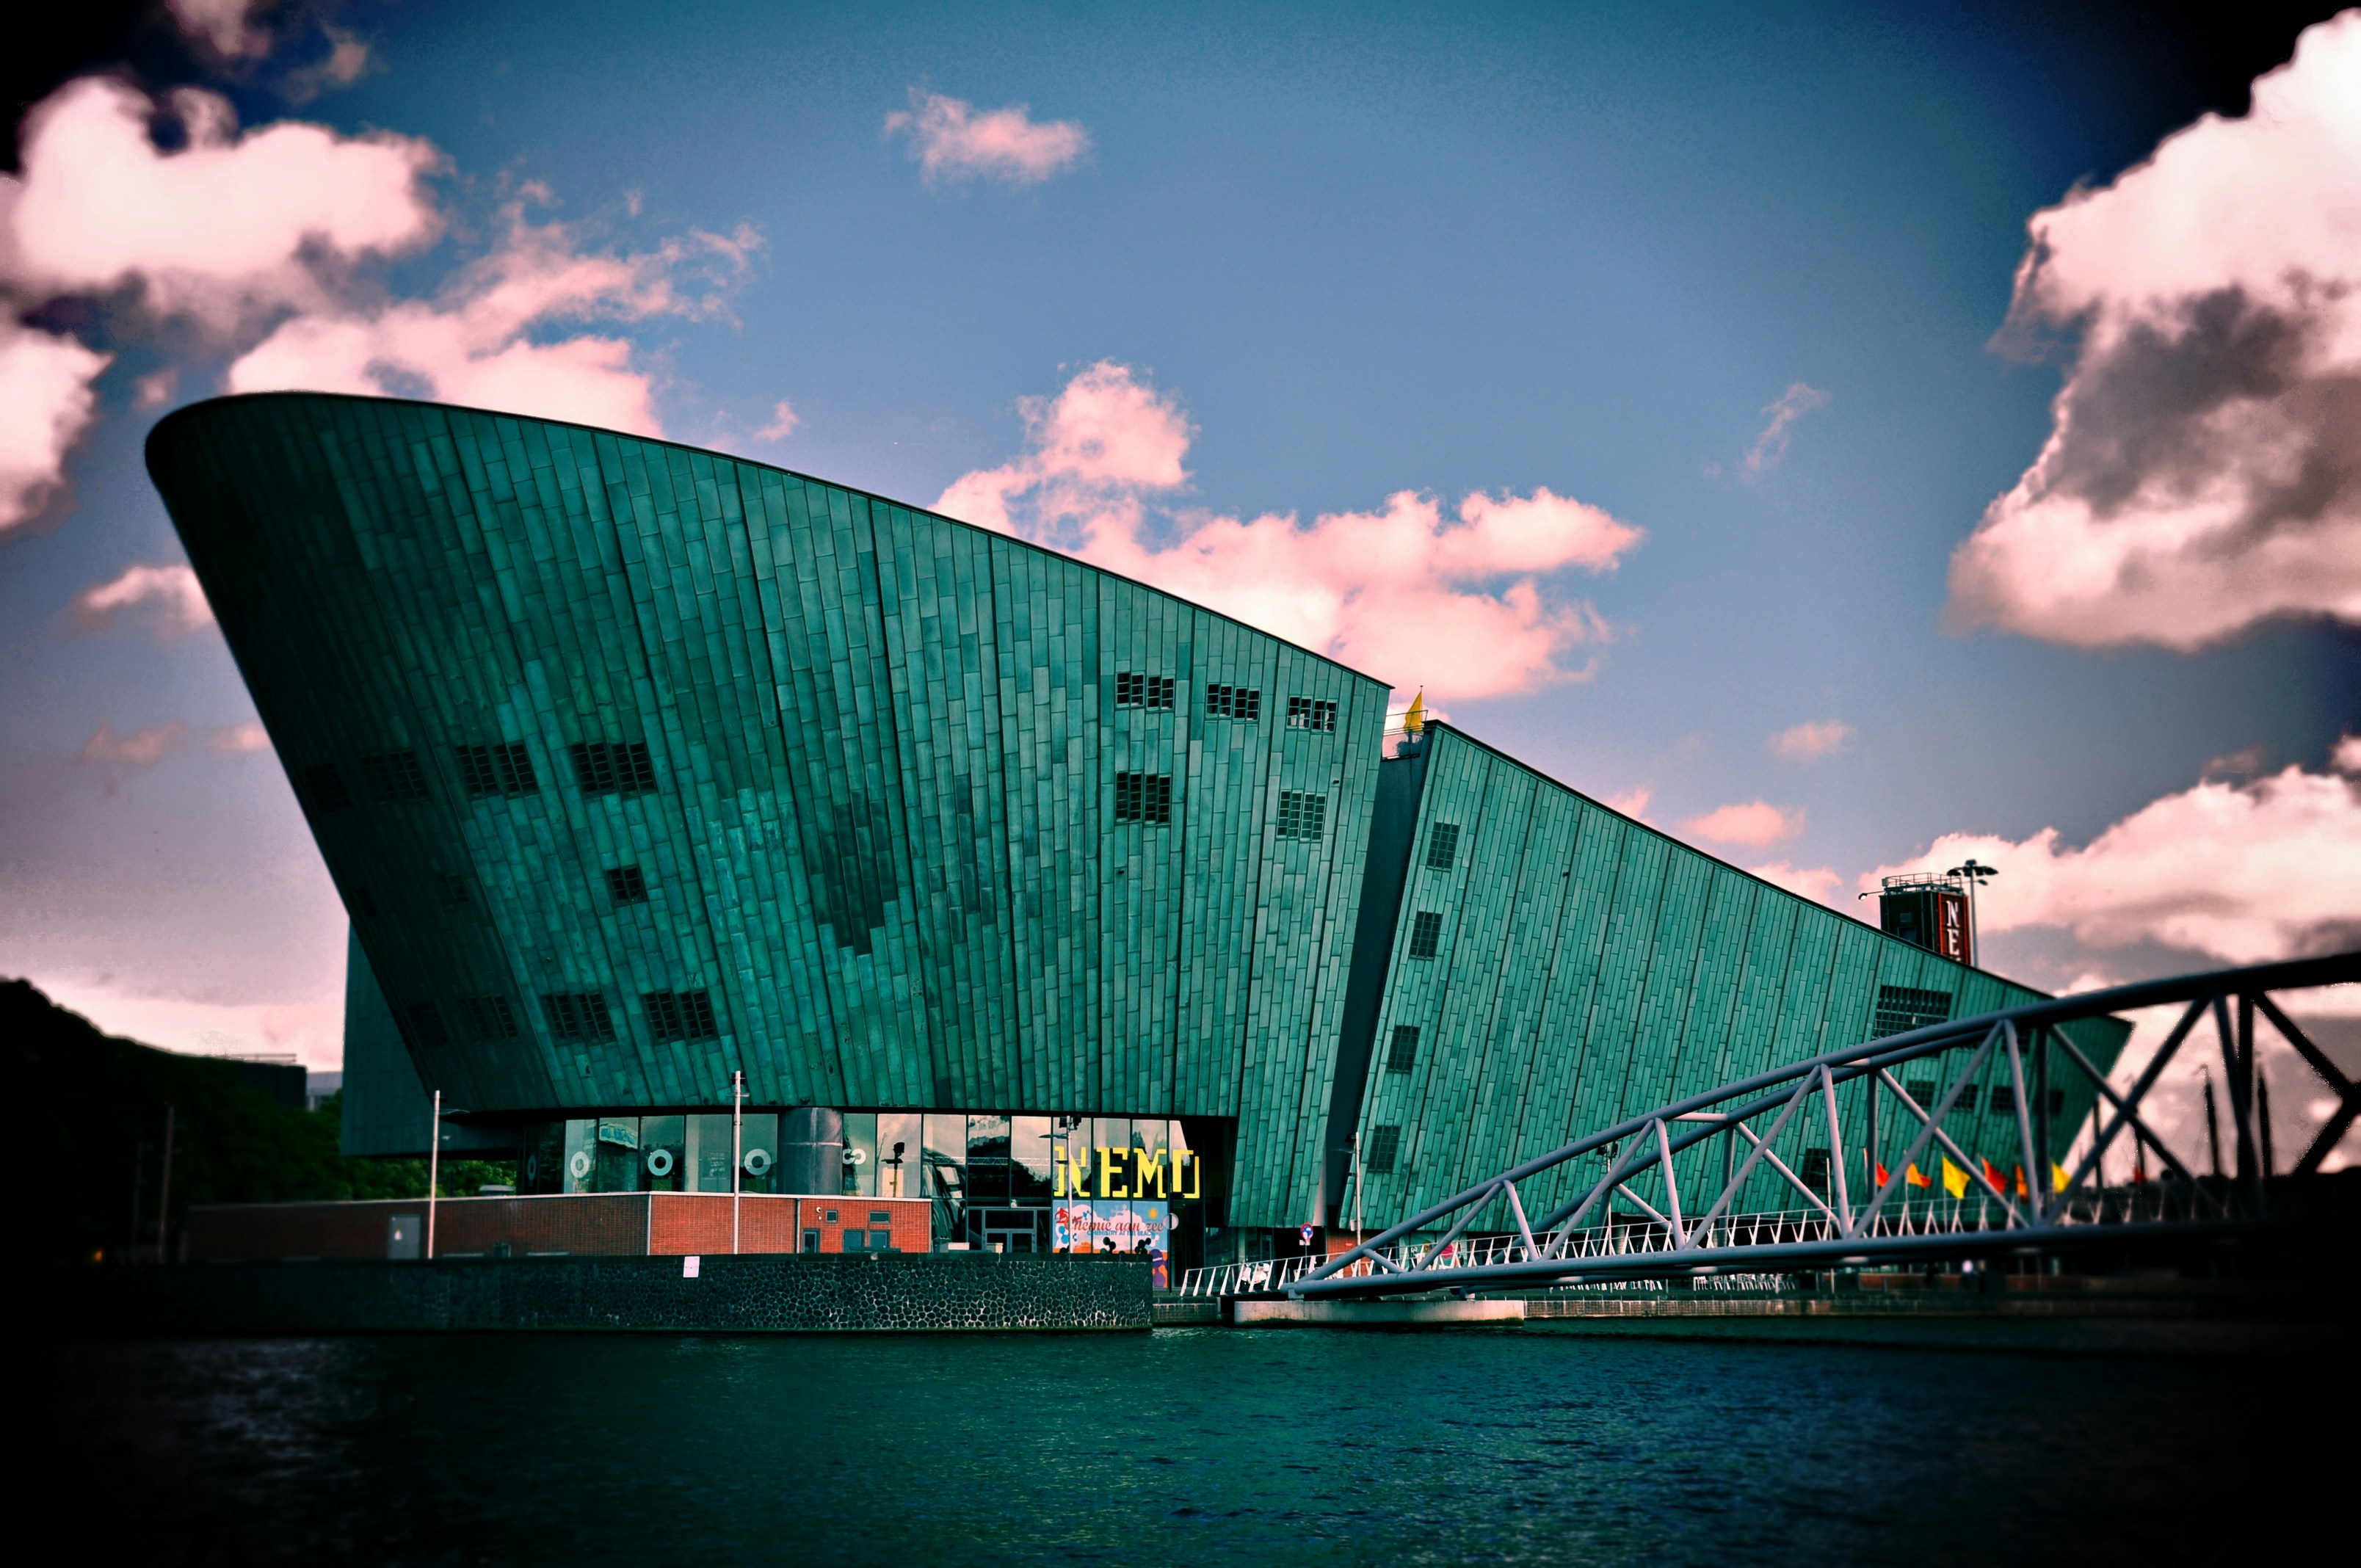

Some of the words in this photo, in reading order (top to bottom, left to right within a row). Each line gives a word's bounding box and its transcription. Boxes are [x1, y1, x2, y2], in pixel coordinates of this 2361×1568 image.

[1945, 900, 1961, 961] NE
[1053, 1146, 1200, 1199] NEMO
[1115, 1222, 1141, 1231] aan
[1145, 1222, 1164, 1233] zee
